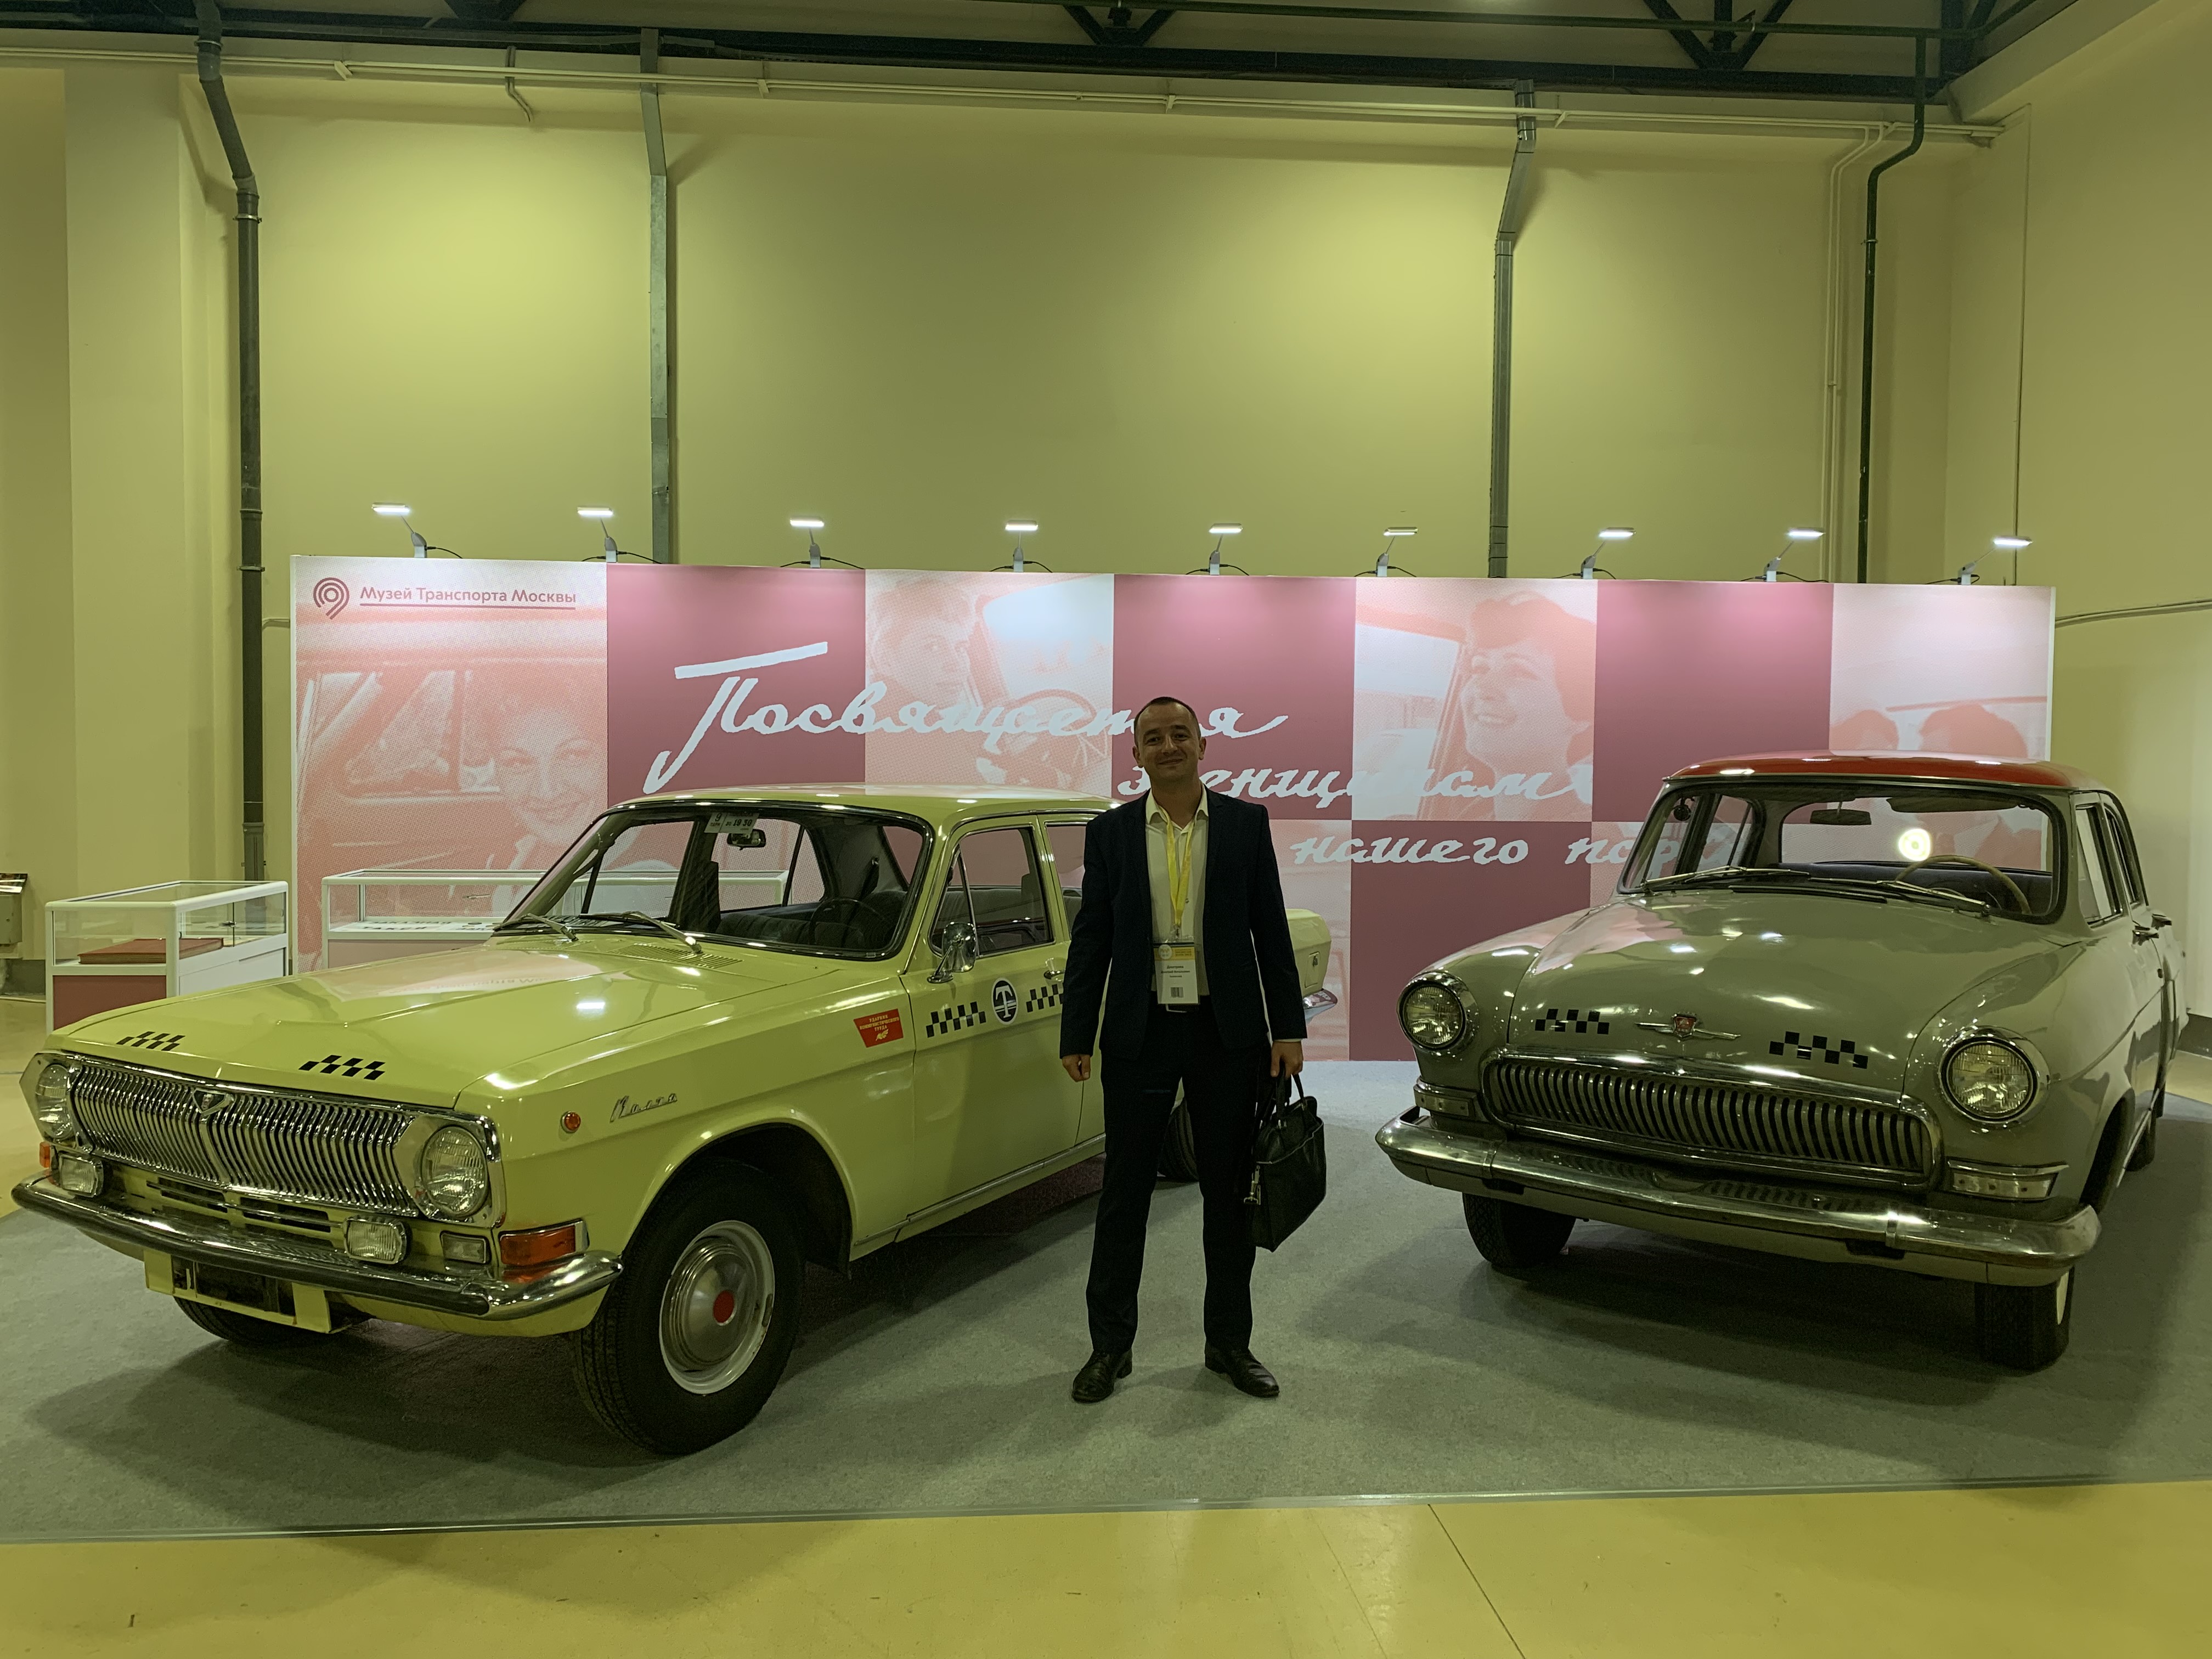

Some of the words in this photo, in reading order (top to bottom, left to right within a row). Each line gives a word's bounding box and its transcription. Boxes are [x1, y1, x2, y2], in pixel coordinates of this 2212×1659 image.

[360, 586, 412, 602] Музей
[416, 588, 507, 603] Транспорта
[511, 589, 577, 603] Москвы
[1290, 837, 1529, 865] нашего
